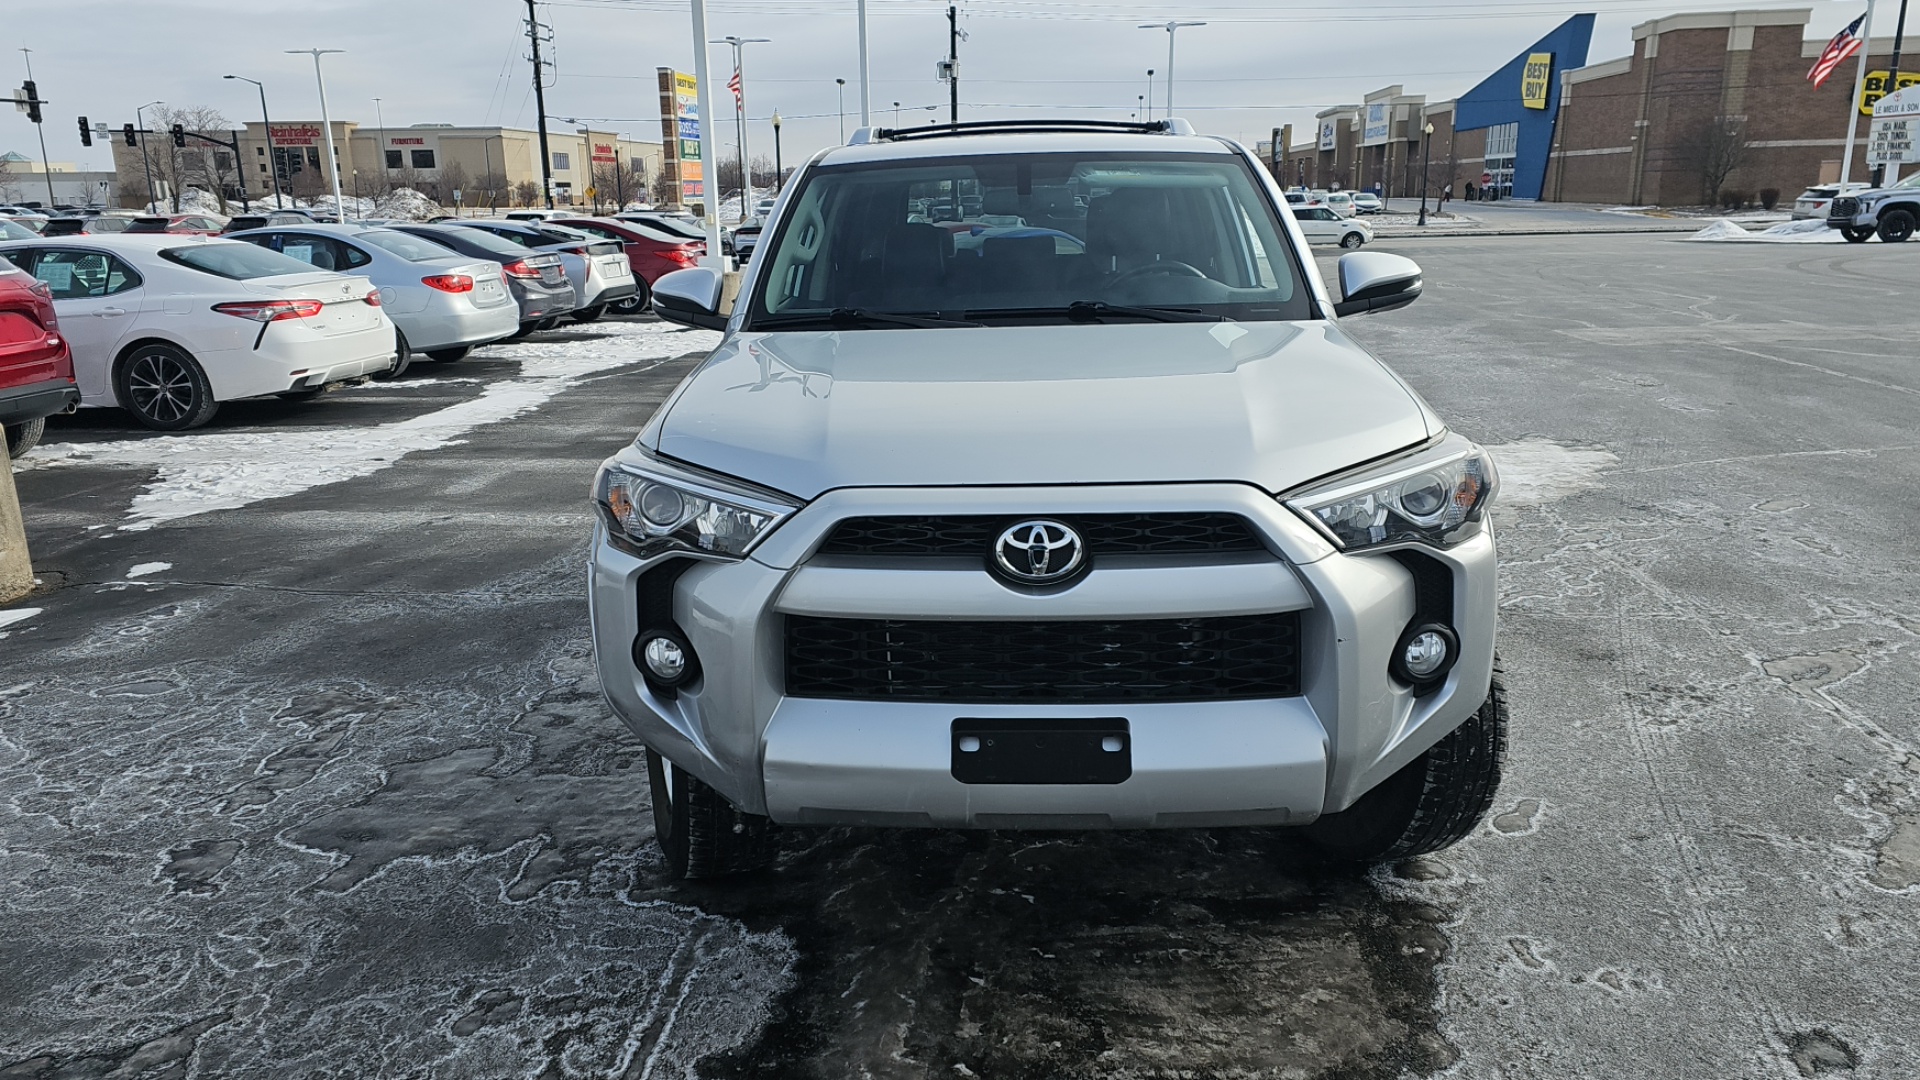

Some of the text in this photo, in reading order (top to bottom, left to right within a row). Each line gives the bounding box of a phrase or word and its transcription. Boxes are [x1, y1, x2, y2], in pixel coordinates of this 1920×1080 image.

[1526, 62, 1548, 79] BEST
[676, 77, 687, 88] BEST
[1525, 81, 1544, 98] BUY
[1875, 106, 1881, 114] LE
[1907, 103, 1920, 112] SON
[275, 137, 313, 145] SUPERSTORE
[1891, 131, 1909, 141] TUNDRA
[1886, 141, 1911, 151] FINANCING
[1876, 152, 1888, 160] PLUS
